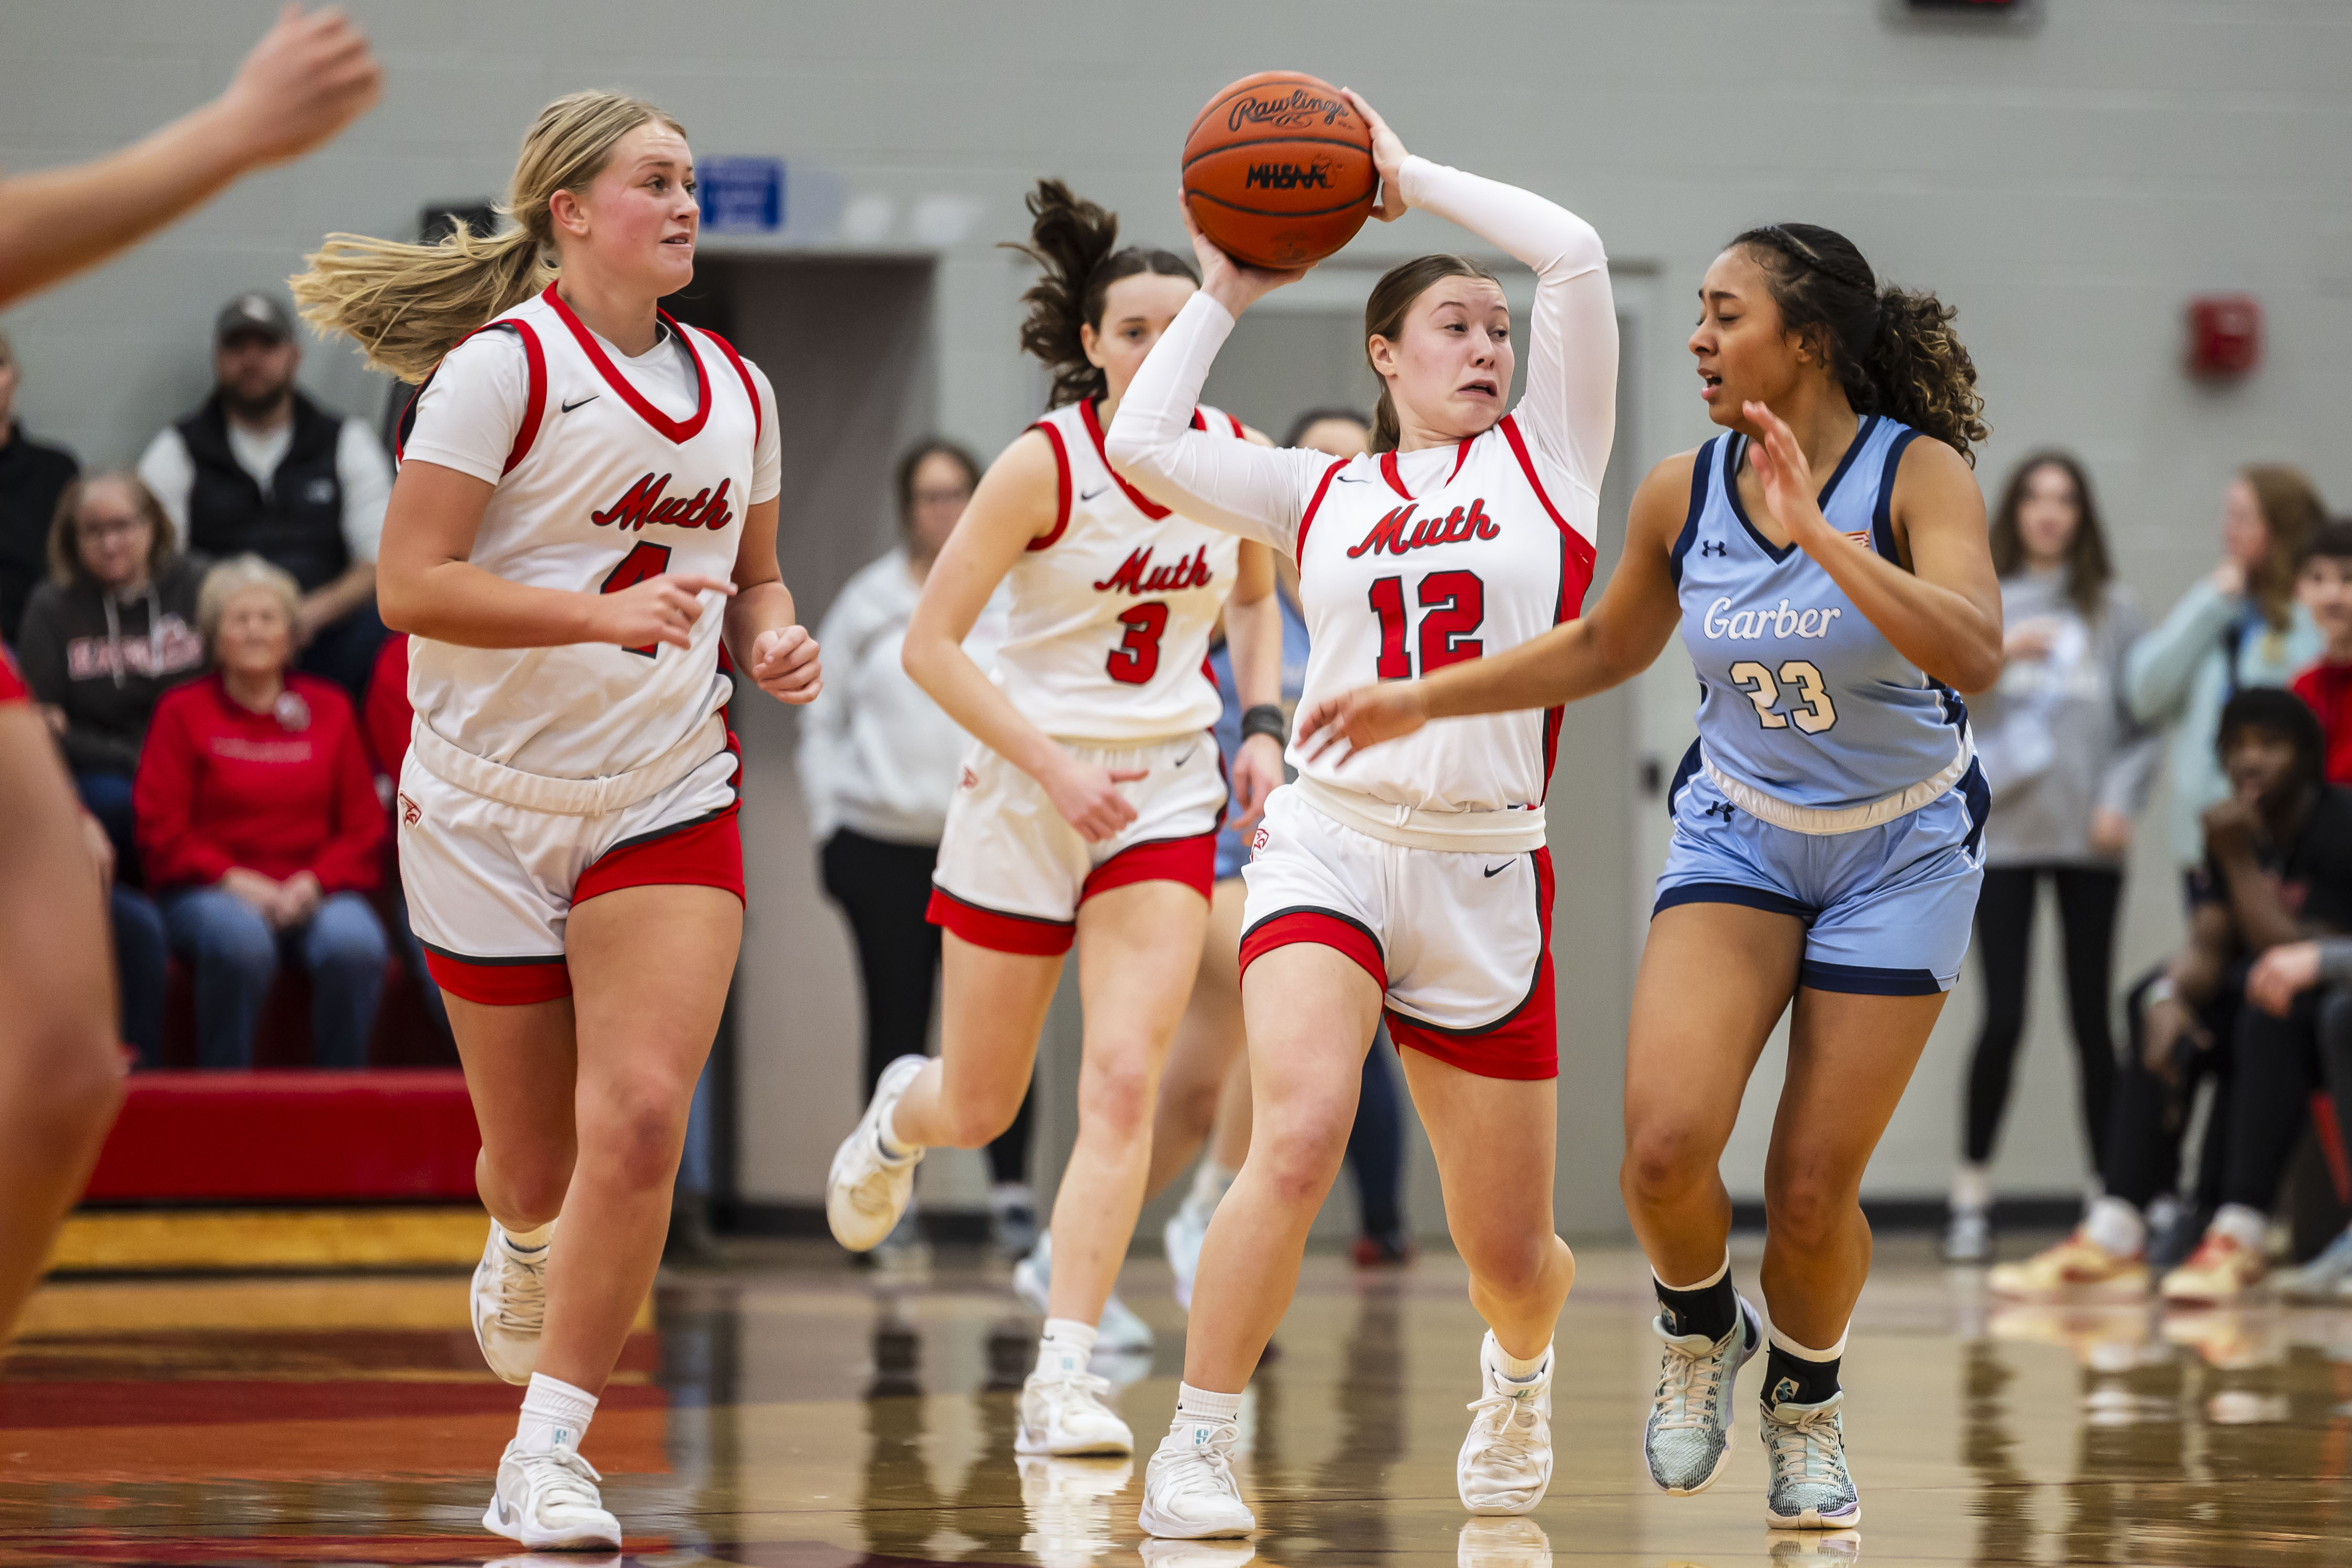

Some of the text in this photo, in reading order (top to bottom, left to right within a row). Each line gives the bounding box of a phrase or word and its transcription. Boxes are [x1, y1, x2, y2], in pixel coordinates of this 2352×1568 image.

[1228, 89, 1349, 132] Rawlings
[591, 472, 732, 531] Muth
[1347, 498, 1500, 558] Muth
[1093, 544, 1213, 596] Muth
[1106, 601, 1169, 685] 3
[1368, 569, 1484, 684] 12
[1703, 596, 1842, 639] Garber
[1729, 660, 1838, 736] 23
